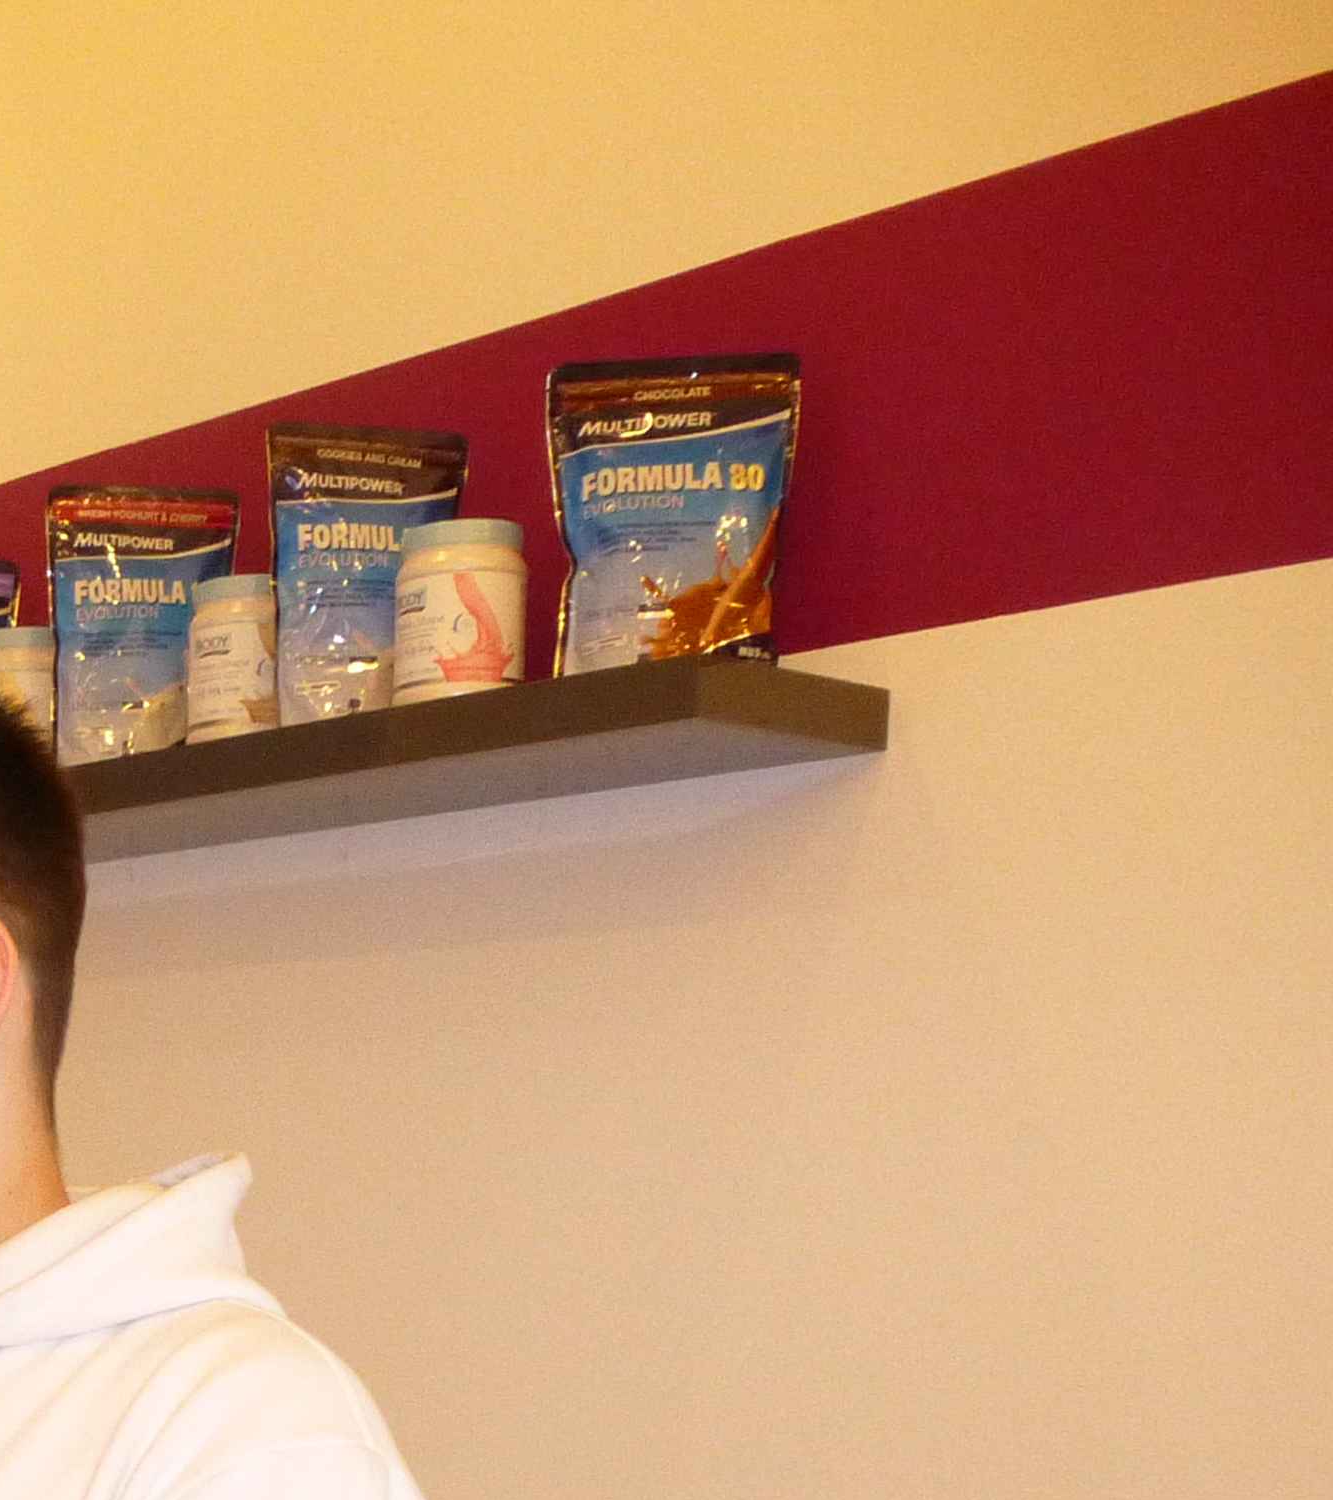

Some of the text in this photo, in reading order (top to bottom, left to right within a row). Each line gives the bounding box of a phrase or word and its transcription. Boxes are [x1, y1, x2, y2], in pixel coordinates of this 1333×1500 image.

[633, 386, 712, 402] CHOCOLATE
[298, 472, 405, 494] MULTIPOWER
[582, 462, 765, 501] FORMULA 80
[73, 531, 175, 551] MULTIPOWER
[297, 523, 402, 552] FORMUL
[74, 578, 187, 606] FORMULA
